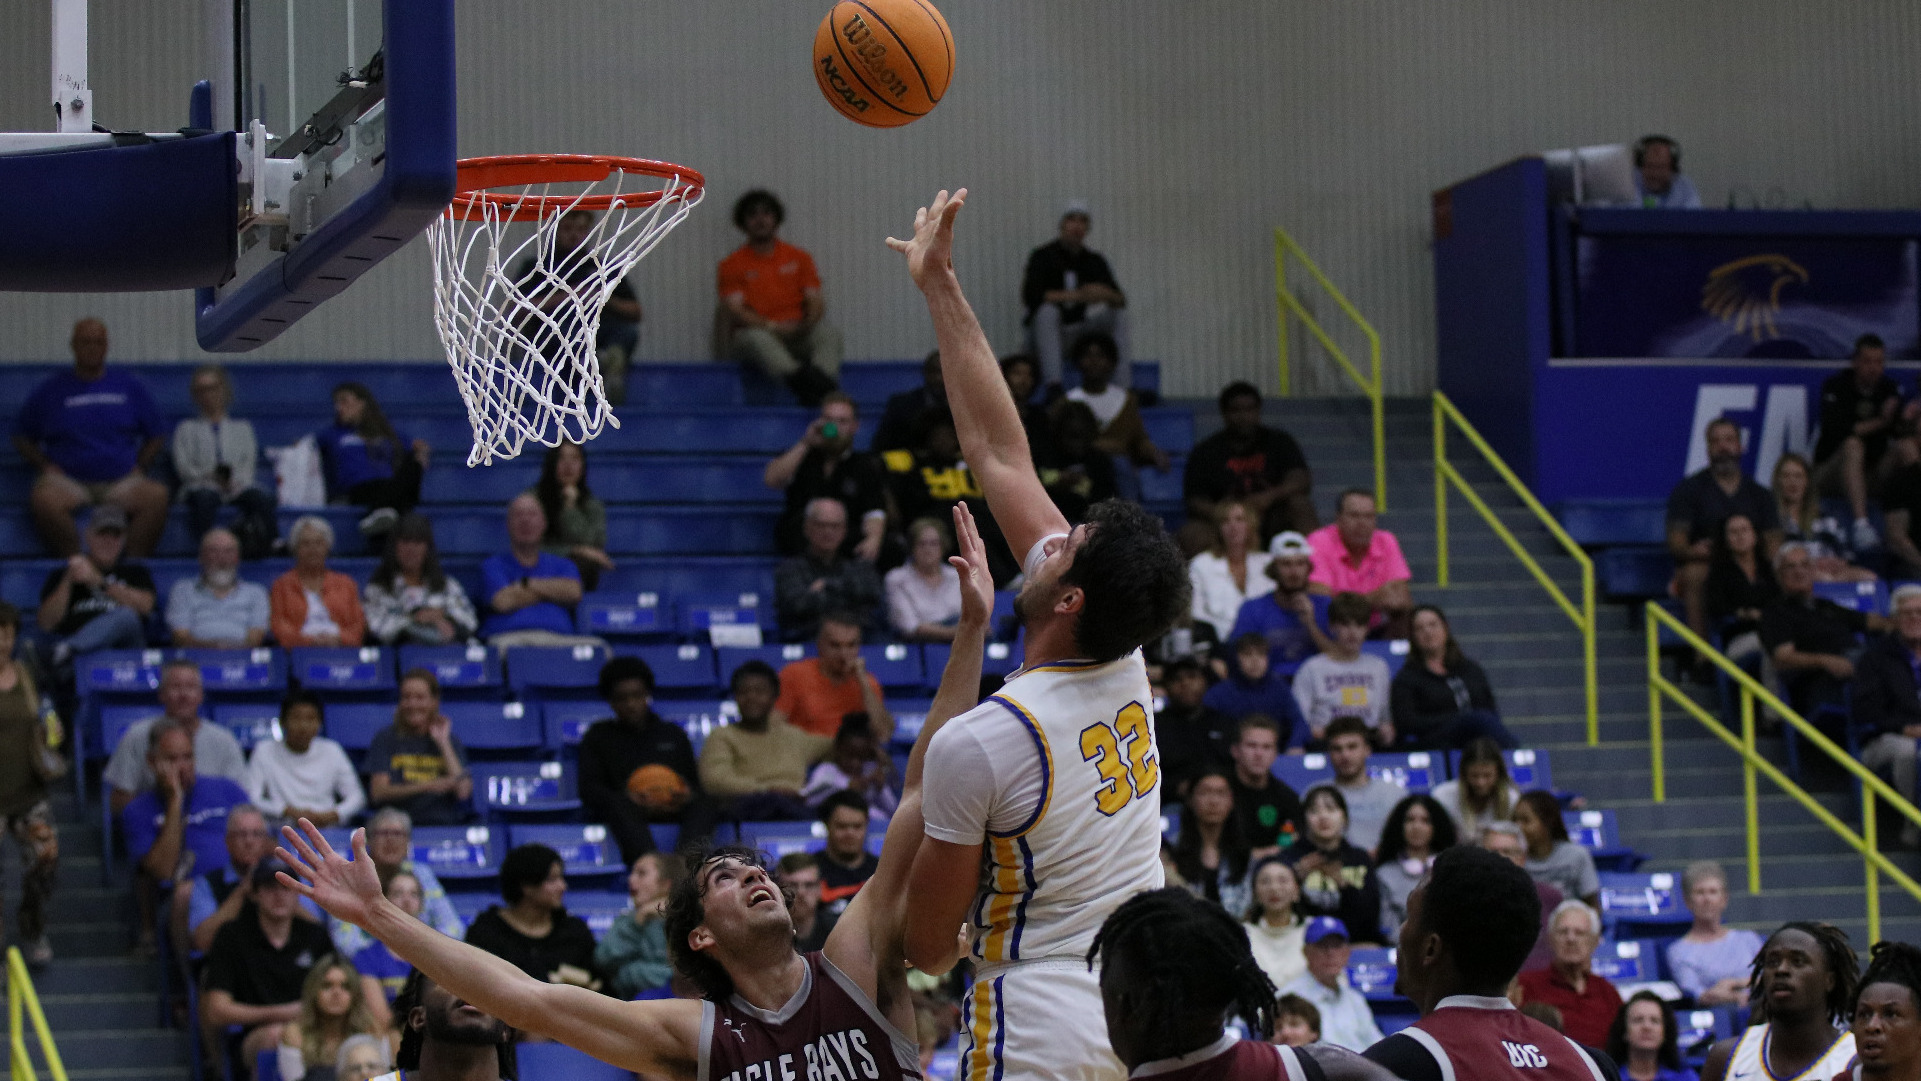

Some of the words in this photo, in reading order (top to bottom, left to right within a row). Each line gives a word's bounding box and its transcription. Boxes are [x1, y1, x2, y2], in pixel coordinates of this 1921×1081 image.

[821, 55, 870, 113] NCAA
[842, 13, 908, 98] Wilson
[1079, 700, 1158, 817] 32
[804, 1029, 879, 1081] RAYS
